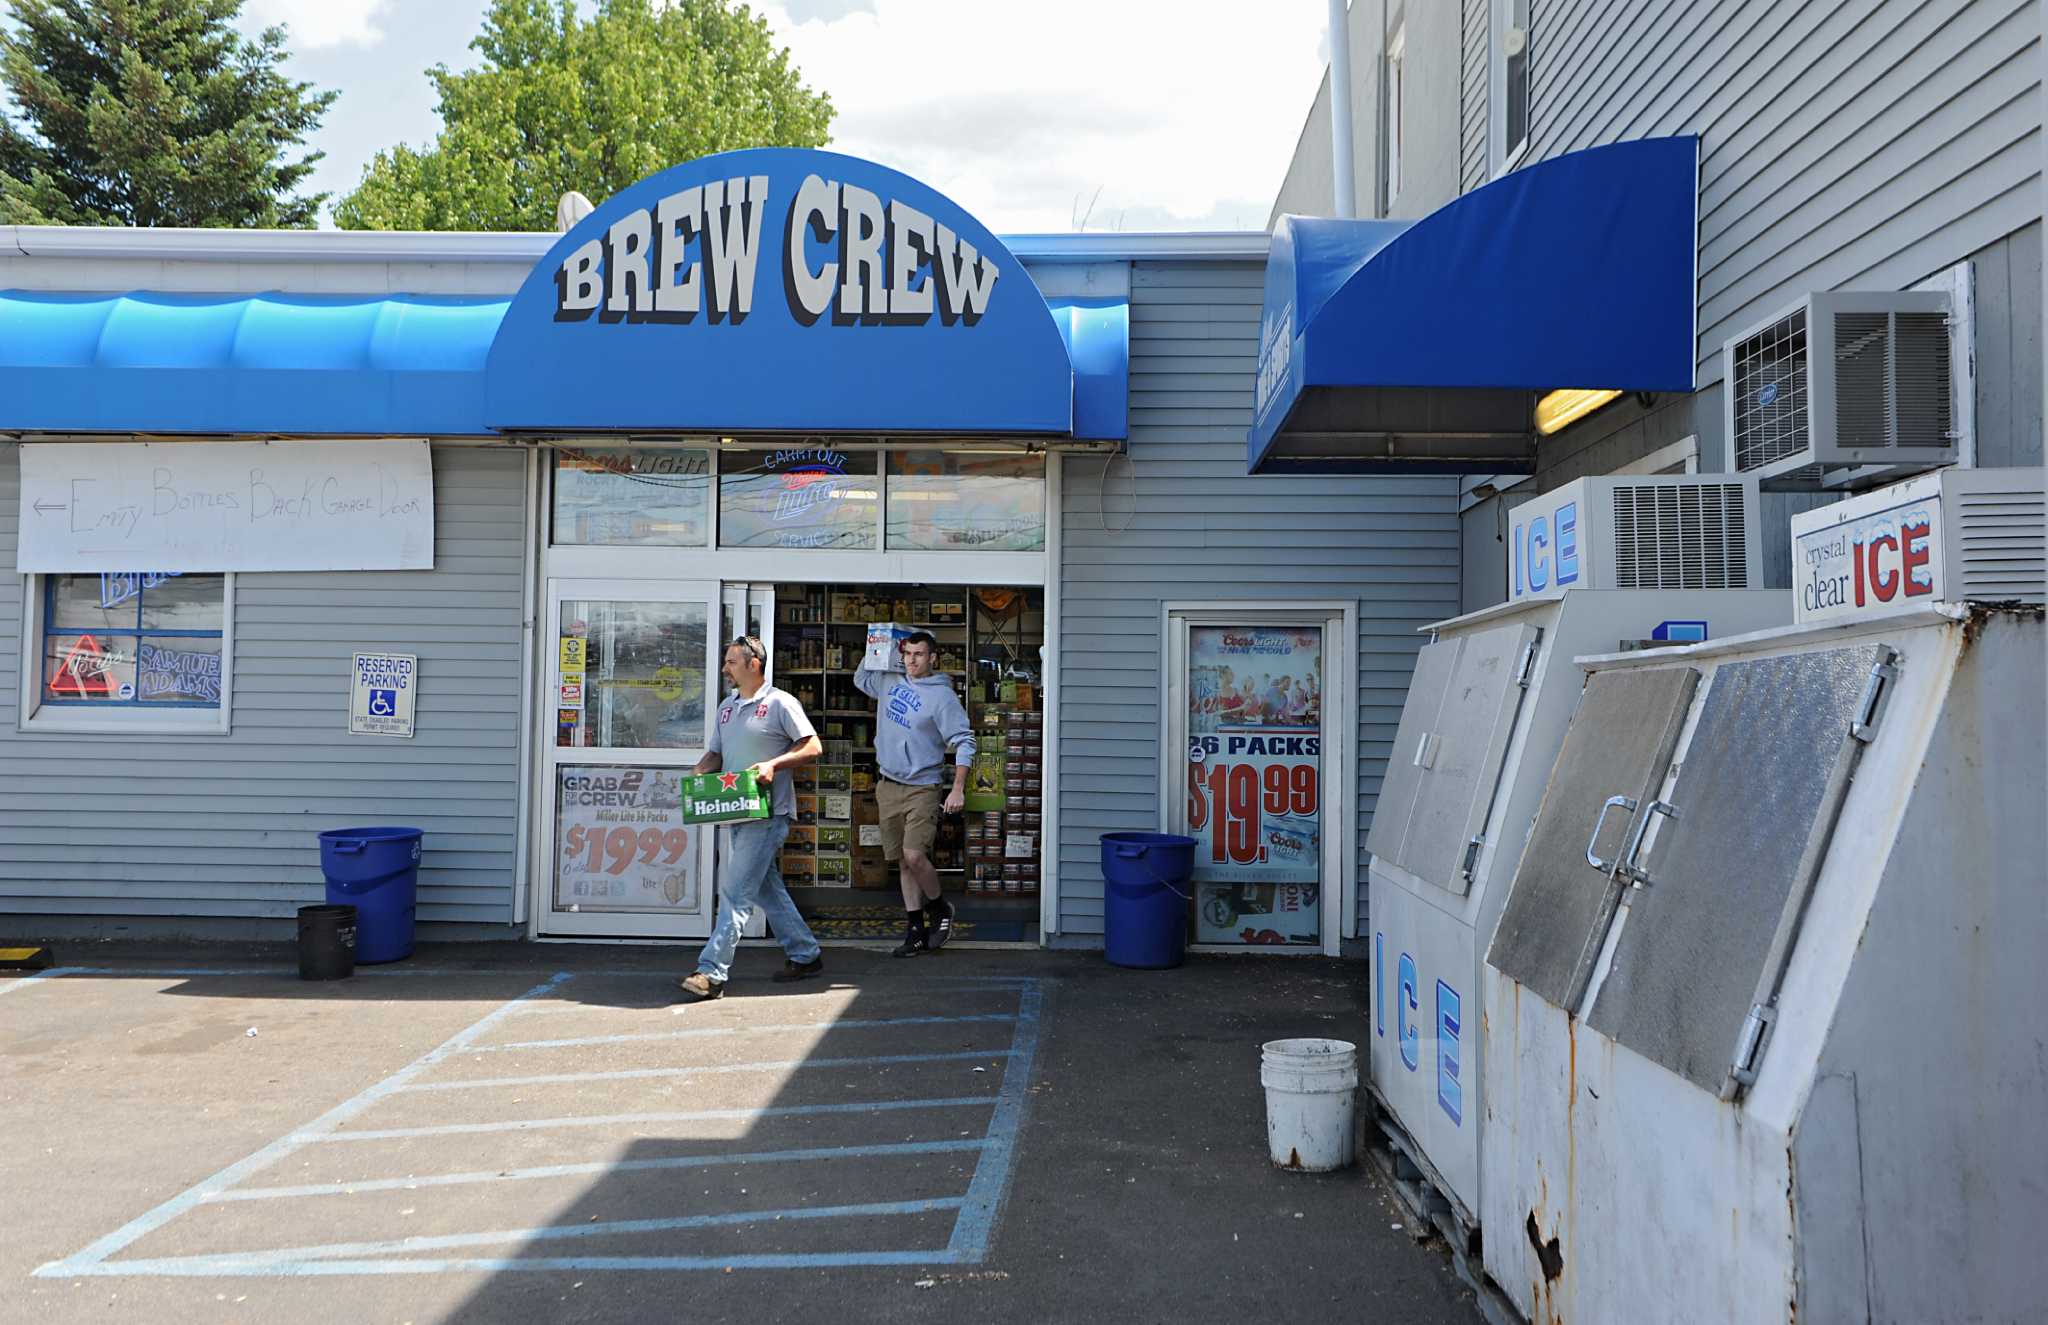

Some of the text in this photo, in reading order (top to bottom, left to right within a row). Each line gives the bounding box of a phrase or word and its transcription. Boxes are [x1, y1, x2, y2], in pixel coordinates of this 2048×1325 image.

[555, 174, 1000, 327] BREW CREW
[1515, 501, 1578, 597] ICE
[1805, 509, 1934, 608] crystal ICE
[1804, 573, 1850, 612] clear
[141, 644, 219, 677] SAMUE
[357, 658, 412, 674] RESERVED
[361, 673, 407, 689] PARKING
[1228, 736, 1321, 756] PACKS
[564, 771, 643, 791] GRAB 2
[579, 792, 637, 807] CREW
[1376, 931, 1462, 1128] ICE
